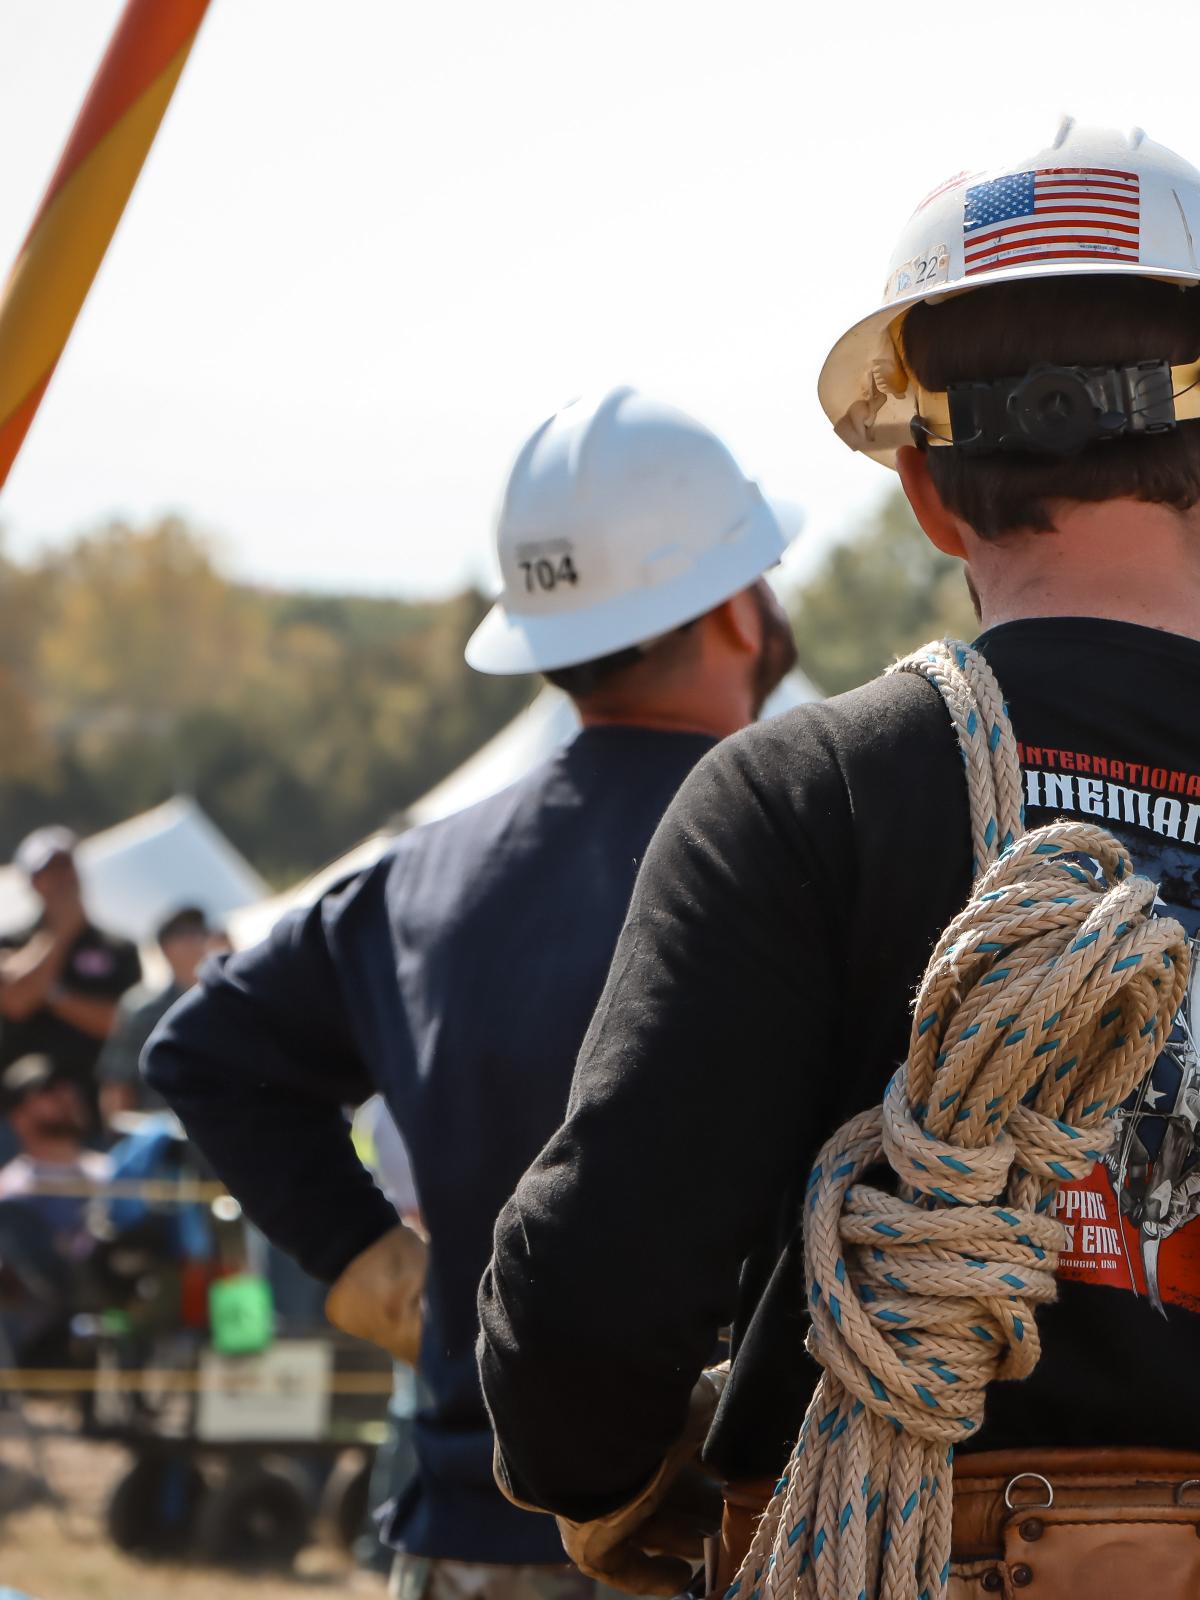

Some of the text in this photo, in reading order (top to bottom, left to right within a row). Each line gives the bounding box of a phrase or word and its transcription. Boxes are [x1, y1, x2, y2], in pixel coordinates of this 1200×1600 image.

[915, 256, 938, 284] 22
[518, 554, 578, 593] 704
[1051, 1190, 1107, 1221] PPING
[1082, 1225, 1122, 1256] EMC
[1057, 1258, 1117, 1270] EORGIA, USA
